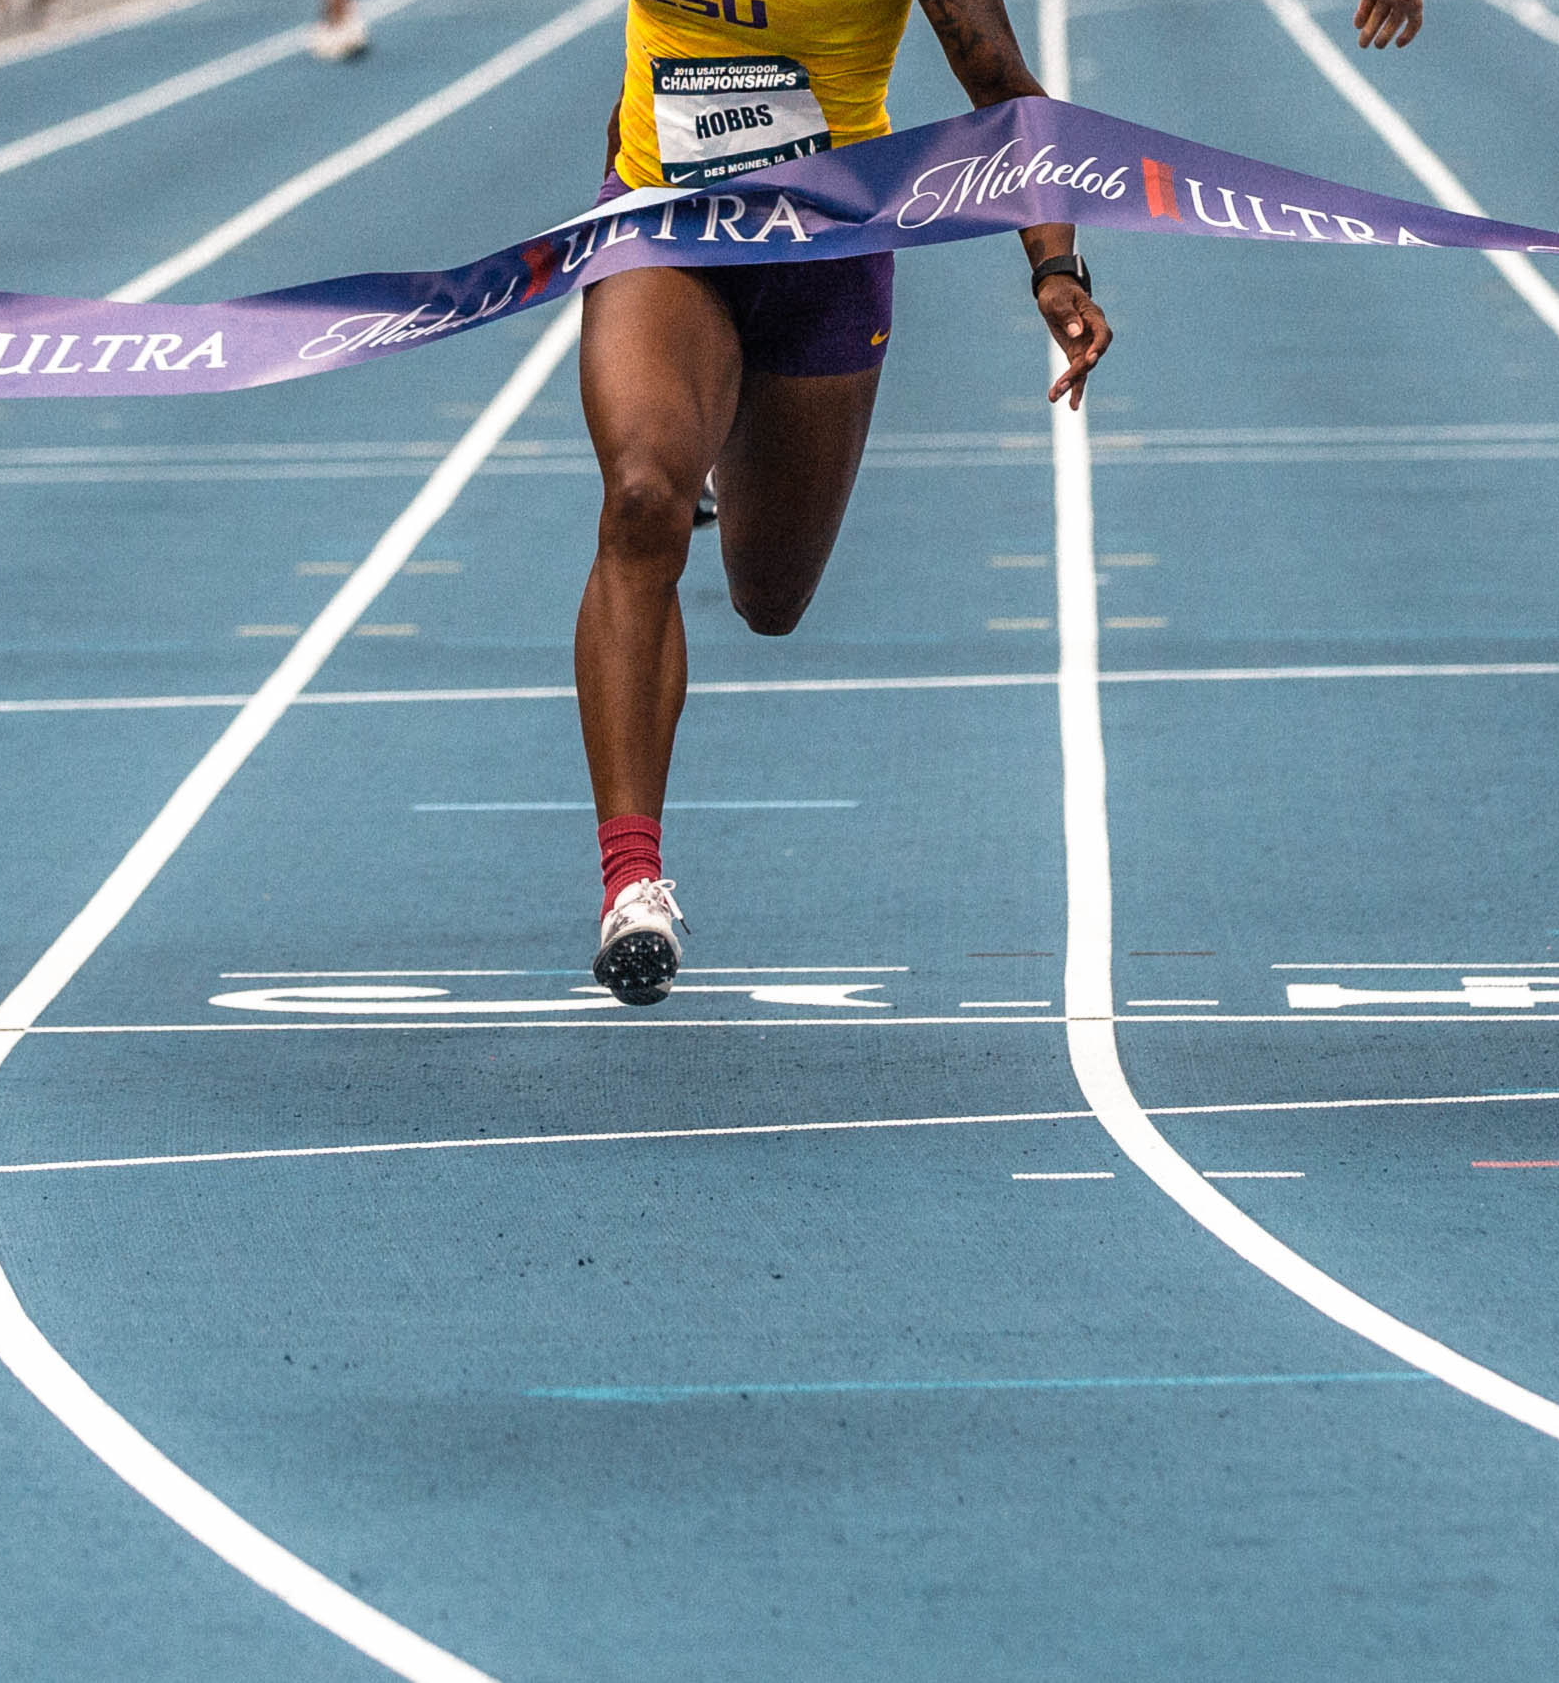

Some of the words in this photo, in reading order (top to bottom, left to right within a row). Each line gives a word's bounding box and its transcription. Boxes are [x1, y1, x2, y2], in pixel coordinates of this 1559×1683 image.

[661, 72, 797, 91] CHAMPIONSHIPS
[674, 67, 695, 76] 2018
[696, 66, 726, 76] USATF
[728, 64, 778, 75] OUTDOOR
[695, 104, 773, 140] HOBBS
[704, 166, 725, 178] DES
[727, 159, 772, 175] MOINES,
[774, 155, 785, 166] IA
[896, 137, 1129, 229] Michelob
[1184, 178, 1442, 247] ULTRA
